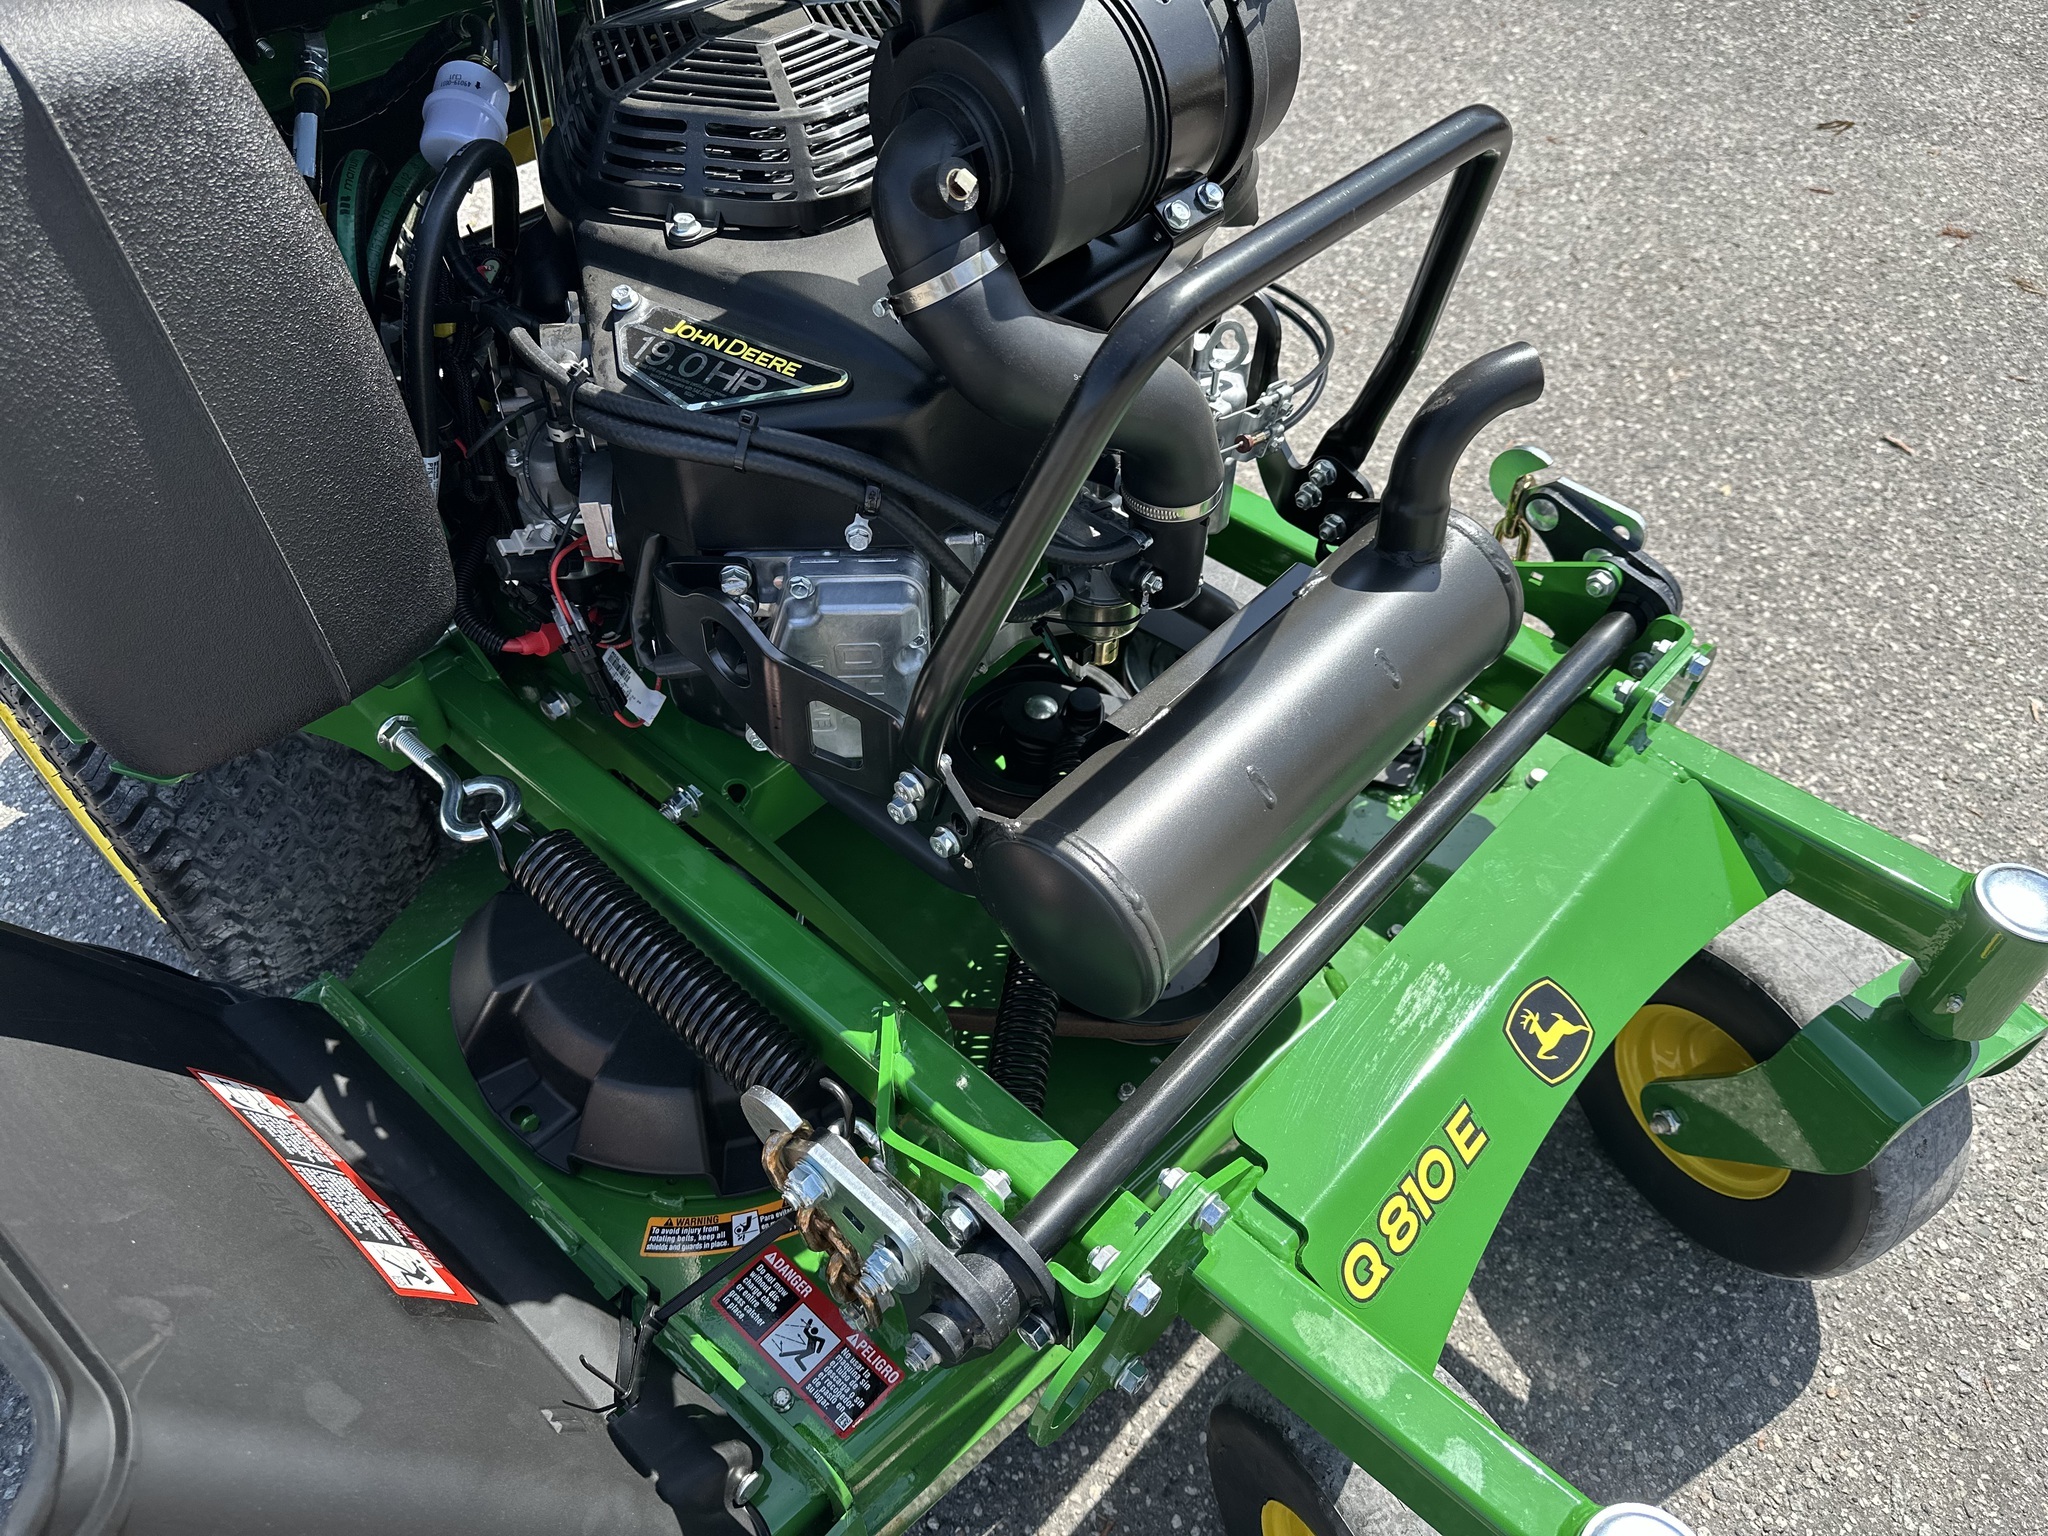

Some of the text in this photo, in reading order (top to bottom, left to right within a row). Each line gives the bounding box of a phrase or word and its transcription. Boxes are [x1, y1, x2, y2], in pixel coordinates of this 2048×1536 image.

[662, 319, 802, 378] JOHN DEERE
[632, 336, 709, 378] 19.0
[704, 361, 768, 396] HP
[1341, 1097, 1491, 1304] Q 810 E
[651, 1225, 719, 1236] To avoid injury from
[676, 1215, 719, 1226] WARNING
[759, 1214, 775, 1222] Para
[387, 1215, 443, 1269] PELIGRO
[645, 1242, 668, 1251] shields
[681, 1242, 703, 1252] guards
[703, 1241, 710, 1249] in
[710, 1239, 730, 1249] place.
[648, 1231, 726, 1244] rotating belts, keep all
[749, 1270, 780, 1301] without dis-
[755, 1263, 788, 1296] Do not mow
[772, 1257, 812, 1297] DANGER
[722, 1294, 744, 1321] in place.
[727, 1289, 765, 1326] grass catcher
[735, 1283, 759, 1307] or entire
[742, 1277, 777, 1312] charge chute
[829, 1359, 858, 1389] el tubo de
[840, 1347, 870, 1379] No usar la
[855, 1339, 899, 1383] PELIGRO
[805, 1383, 829, 1409] su lugar.
[811, 1377, 821, 1387] de
[818, 1385, 838, 1404] pasto
[835, 1402, 845, 1412] en
[817, 1371, 827, 1380] el
[823, 1377, 854, 1409] recogedor
[823, 1365, 850, 1393] descarga
[853, 1396, 865, 1408] sin
[859, 1378, 870, 1390] sin
